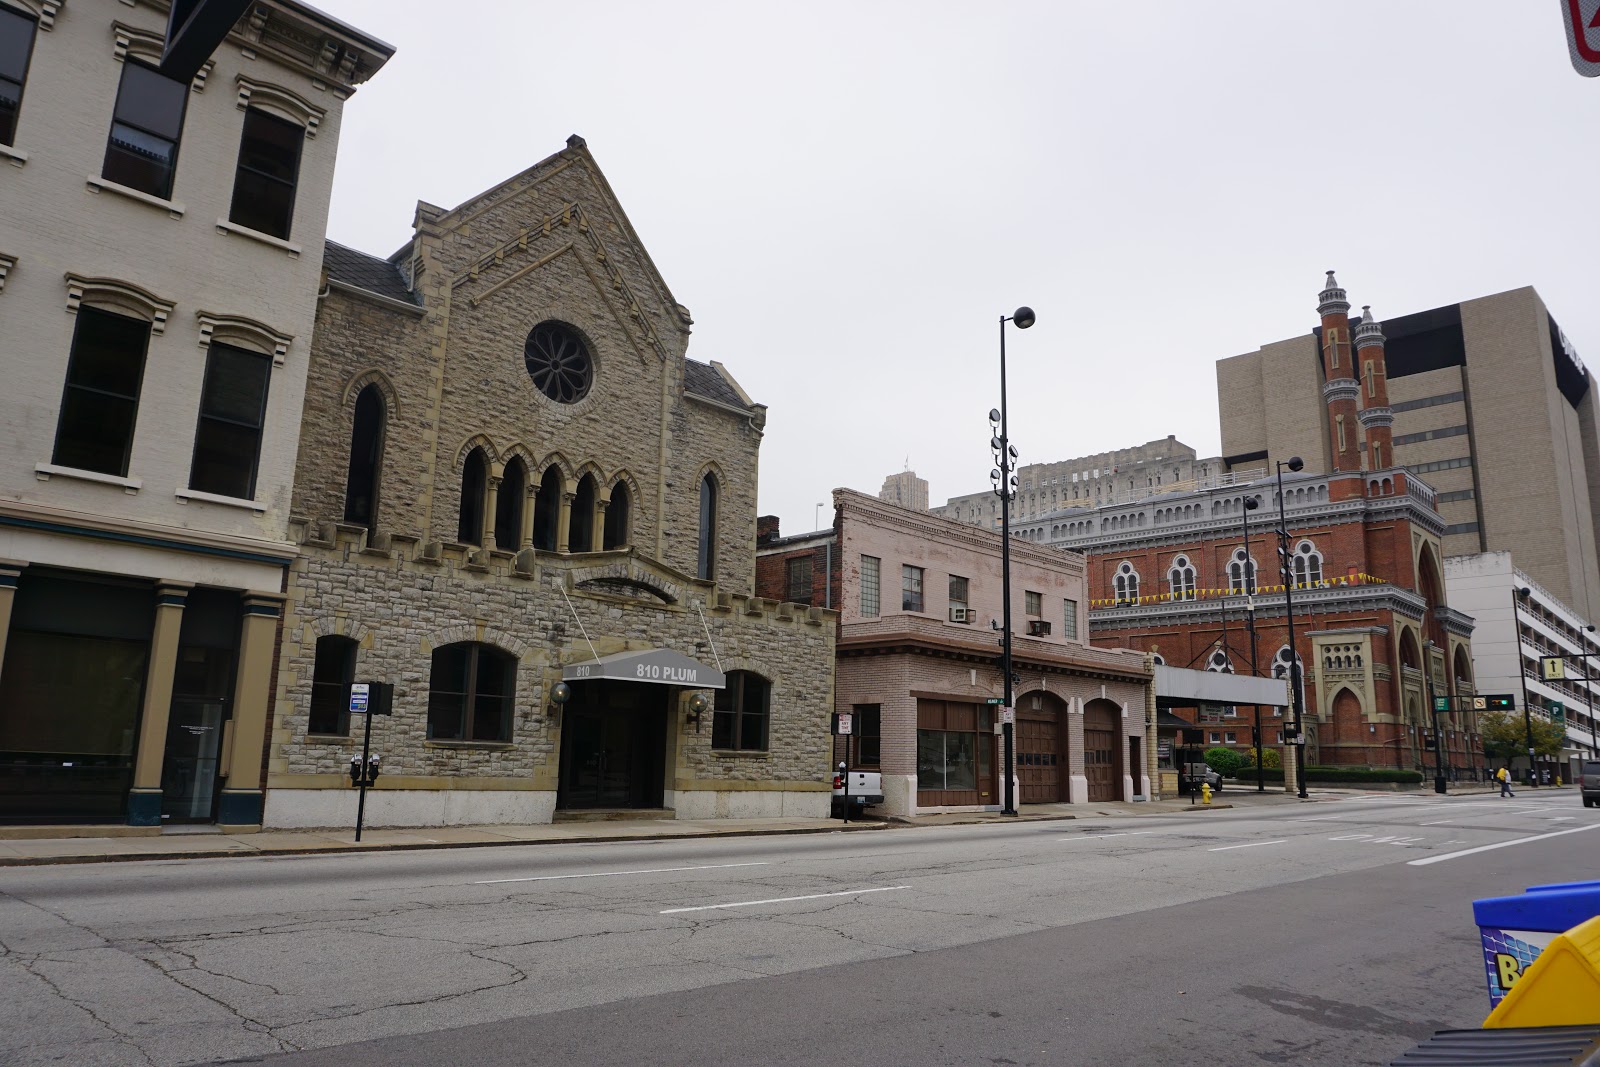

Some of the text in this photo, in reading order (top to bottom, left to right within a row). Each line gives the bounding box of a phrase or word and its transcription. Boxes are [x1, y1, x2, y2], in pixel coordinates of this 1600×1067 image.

[576, 666, 590, 677] 810
[637, 664, 697, 682] 810 PLUM
[1552, 706, 1560, 715] P
